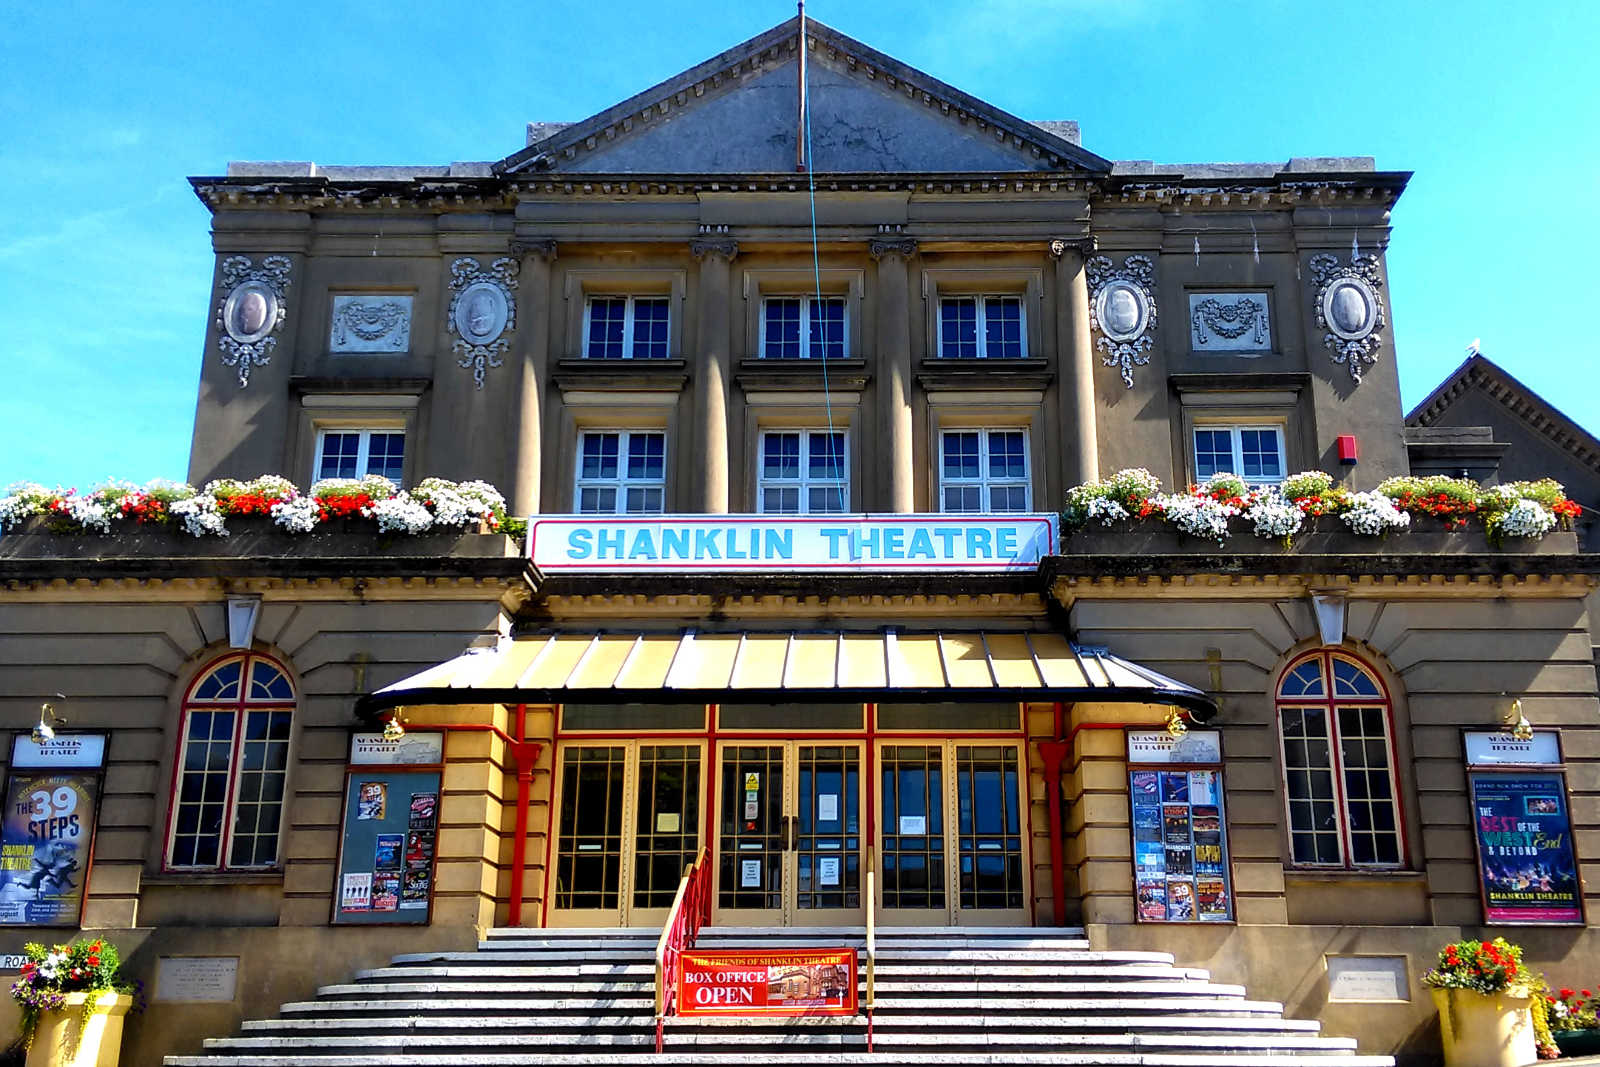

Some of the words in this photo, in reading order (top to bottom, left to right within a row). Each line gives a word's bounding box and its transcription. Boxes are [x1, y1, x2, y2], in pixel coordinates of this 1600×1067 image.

[567, 528, 793, 559] SHANKLIN
[820, 527, 1018, 559] THEATRE
[366, 785, 381, 797] 39
[16, 801, 33, 815] THE
[31, 786, 77, 822] 39
[1479, 807, 1493, 817] THE
[28, 814, 79, 841] STEPS
[1480, 816, 1519, 833] BEST
[1517, 823, 1526, 832] OF
[1526, 823, 1540, 832] THE
[1482, 832, 1532, 847] WEST
[1533, 832, 1563, 850] End
[1488, 846, 1495, 856] &
[1500, 846, 1538, 856] BEYOND
[1174, 886, 1189, 897] 39
[1490, 892, 1534, 900] SHANKLIN
[1536, 892, 1573, 900] THEATRE
[0, 911, 19, 920] ugust
[4, 955, 28, 968] ROA
[693, 958, 708, 966] THE
[711, 958, 744, 966] FRIENDS
[746, 958, 759, 966] OF
[760, 957, 801, 966] SHANKLIN
[804, 956, 842, 965] THEATRE
[685, 972, 713, 984] BOX
[716, 971, 766, 983] OFFICE
[695, 986, 753, 1004] OPEN
